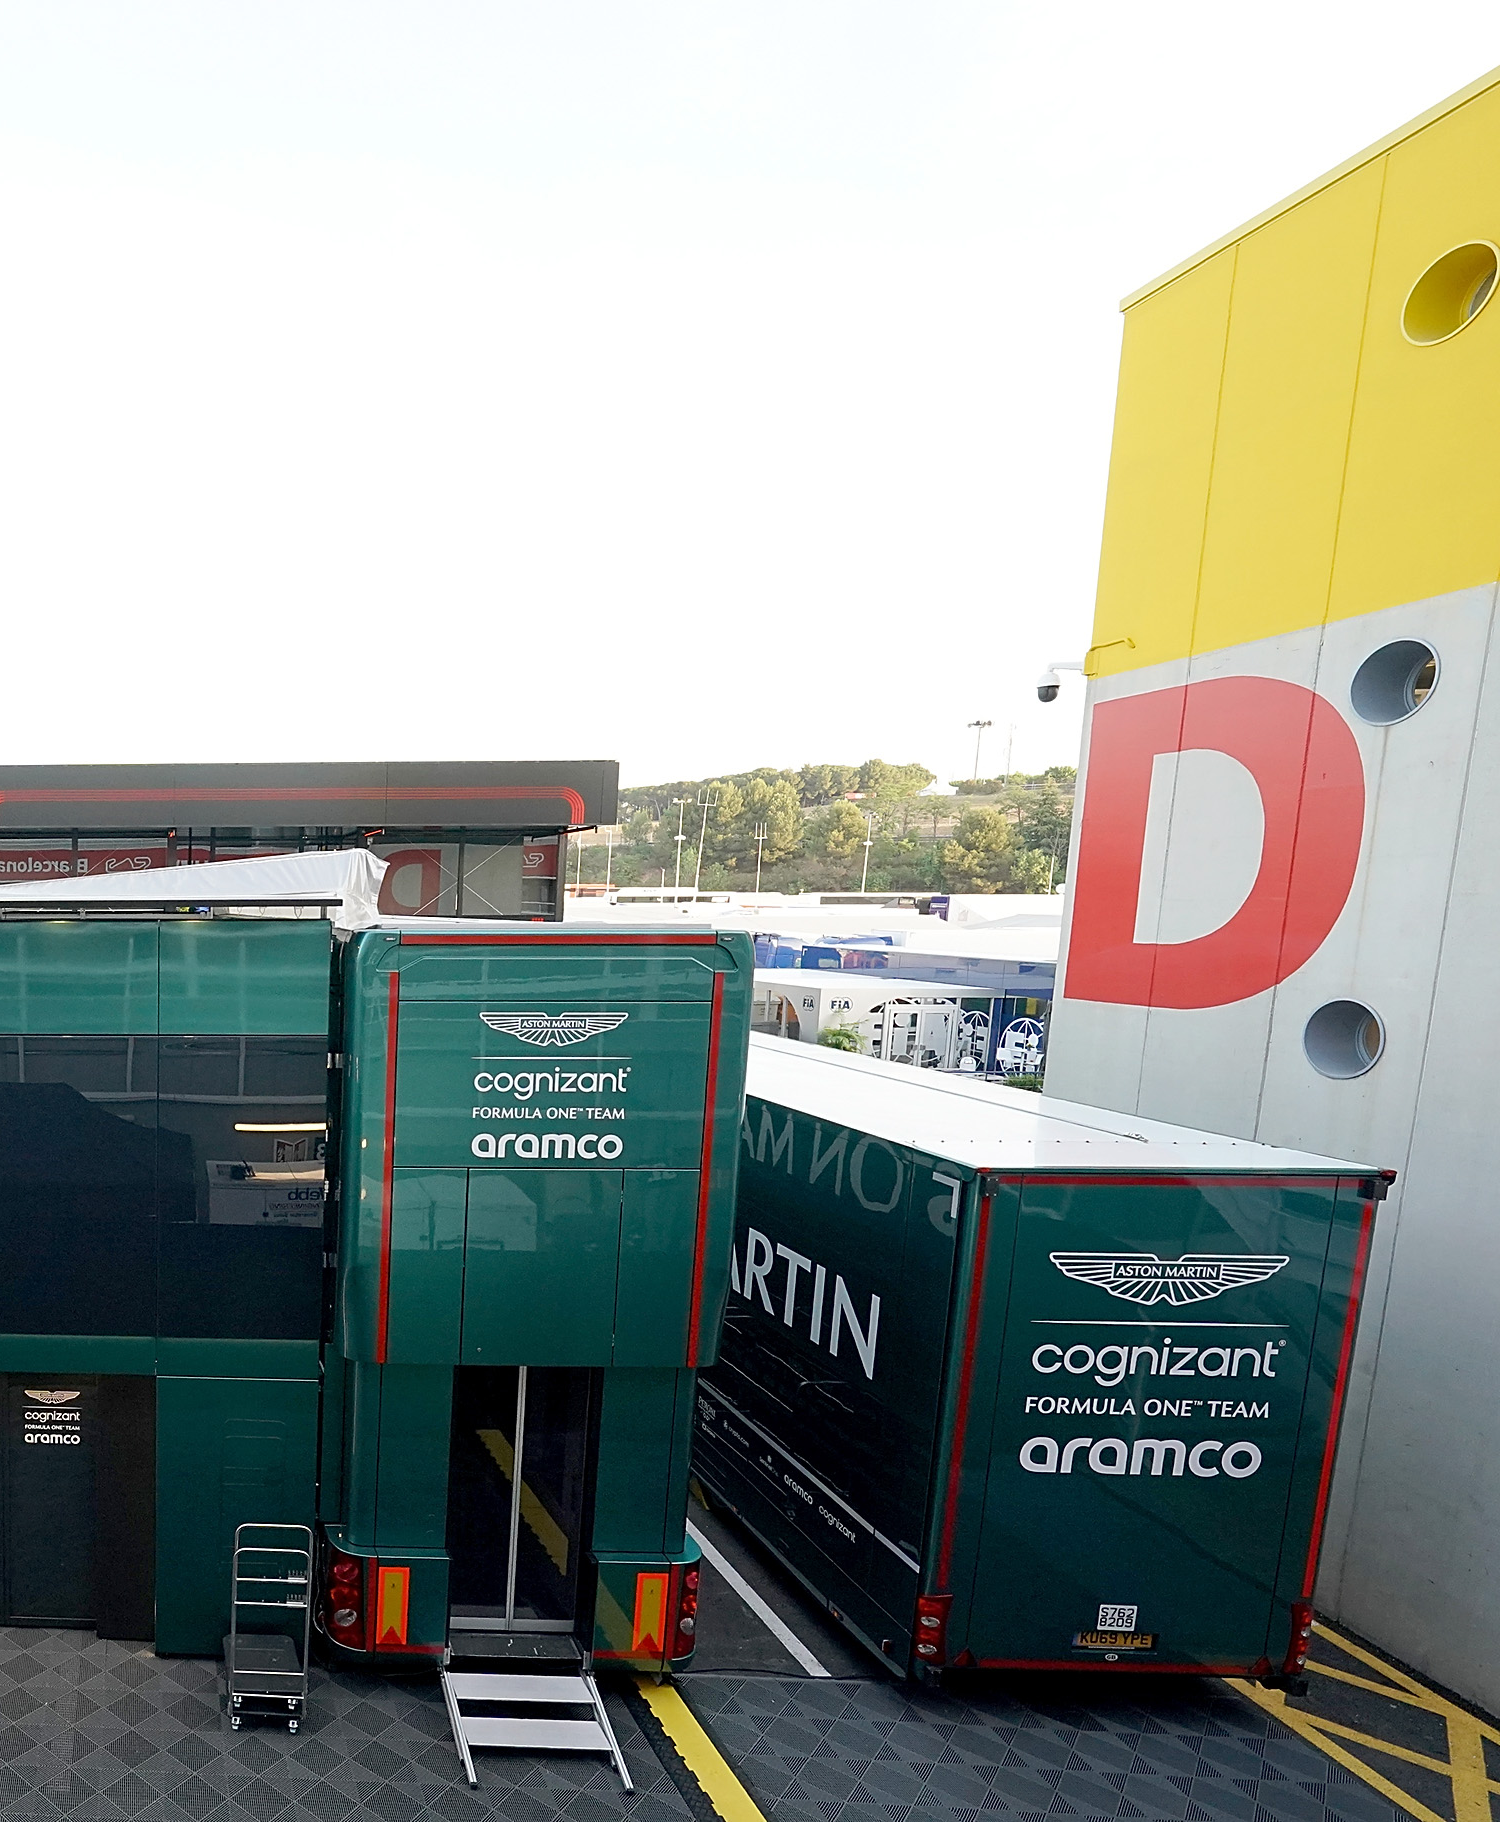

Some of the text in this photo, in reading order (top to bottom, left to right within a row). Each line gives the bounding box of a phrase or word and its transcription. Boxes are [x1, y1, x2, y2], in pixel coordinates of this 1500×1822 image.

[1063, 675, 1366, 1009] D
[521, 1020, 585, 1028] ASTON MARTIN
[472, 1107, 542, 1119] FORMULA
[585, 1108, 625, 1120] TEAM
[471, 1133, 623, 1160] aramco
[1116, 1265, 1218, 1278] ASTON MARTIN
[1024, 1396, 1136, 1416] FORMULA
[1207, 1400, 1269, 1419] TEAM
[24, 1410, 81, 1423] cognizant
[24, 1433, 81, 1445] aramco
[1019, 1436, 1263, 1479] aramco
[784, 1474, 813, 1505] aramco
[818, 1505, 856, 1543] cognizant
[1100, 1607, 1135, 1618] S762
[1099, 1618, 1134, 1628] 8209
[1080, 1632, 1150, 1645] KU69 YPE
